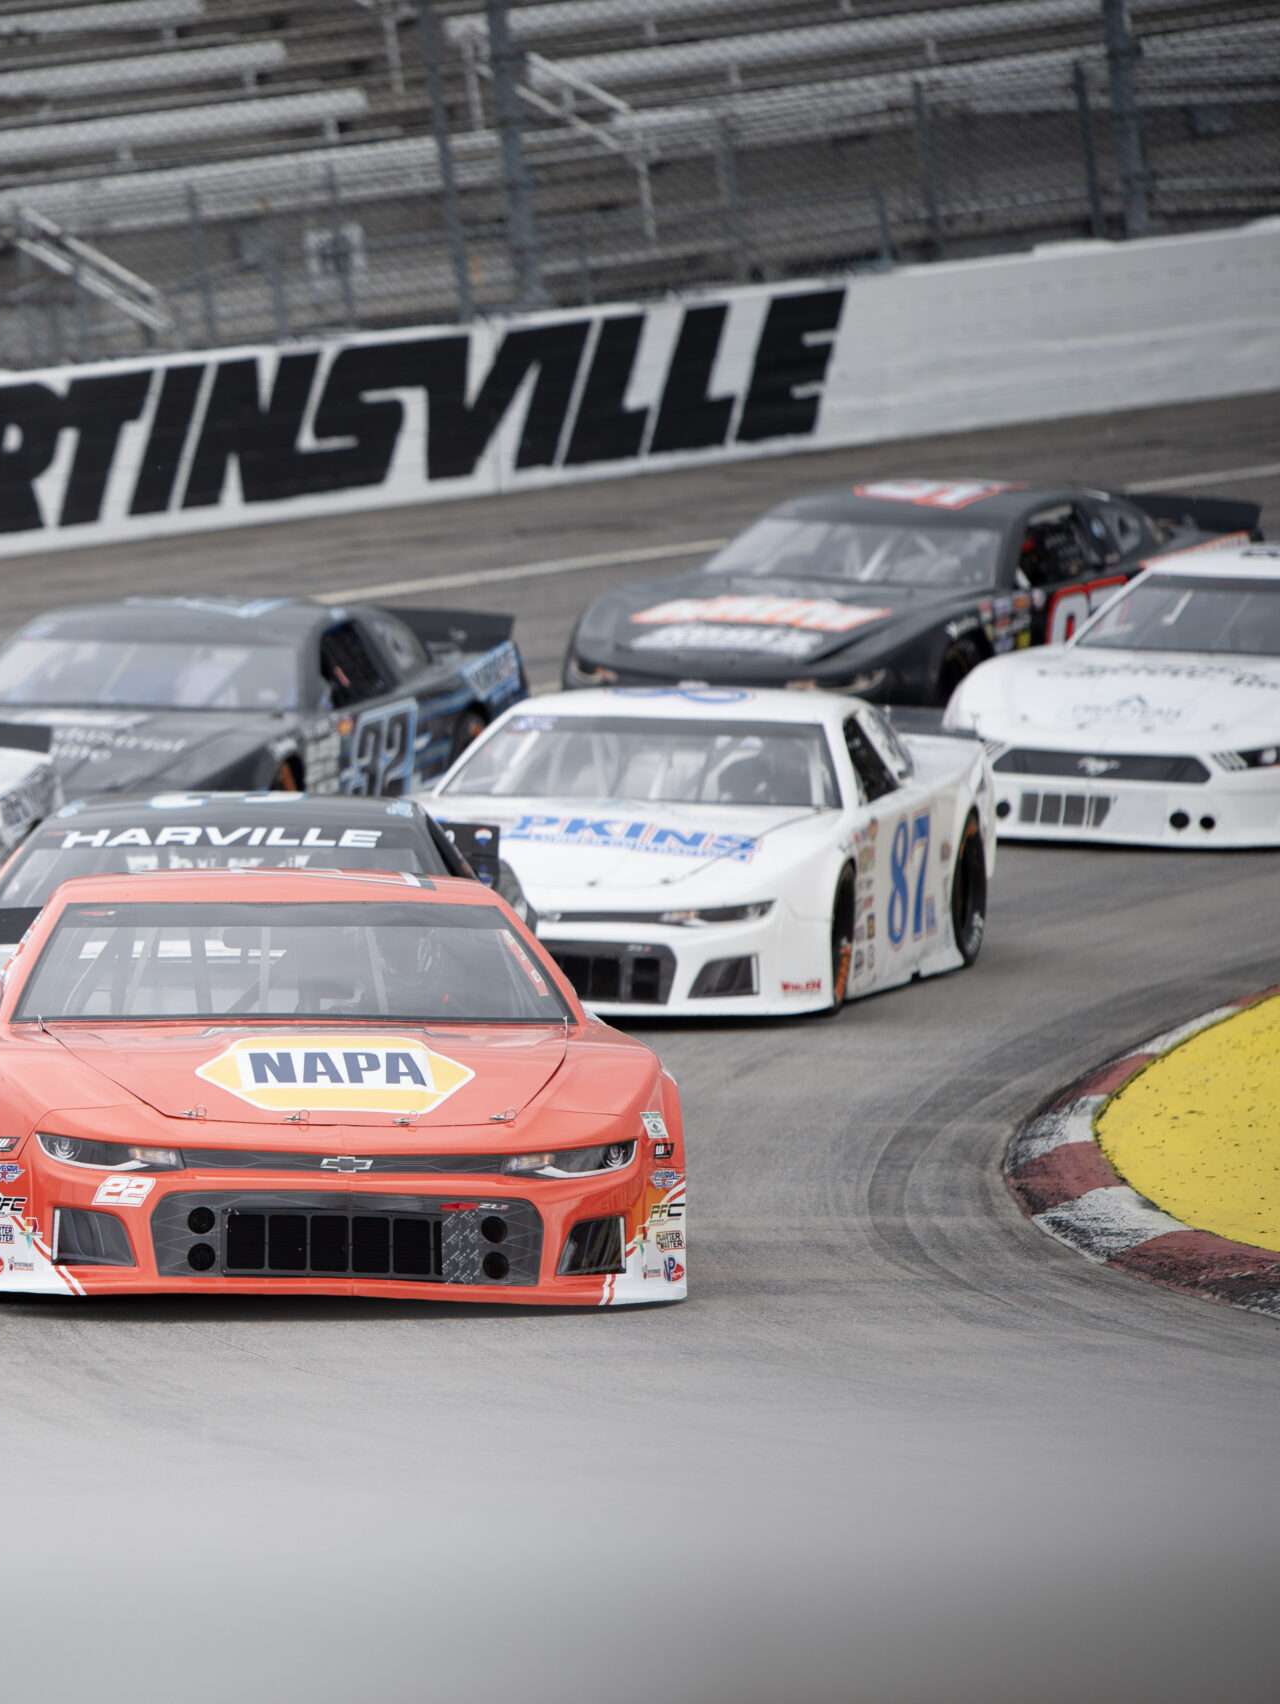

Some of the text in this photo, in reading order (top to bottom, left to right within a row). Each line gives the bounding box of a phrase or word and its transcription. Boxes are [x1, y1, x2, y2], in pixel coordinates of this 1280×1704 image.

[61, 826, 383, 849] HARVILLE
[888, 808, 931, 950] 87
[248, 1052, 427, 1087] NAPA
[91, 1175, 156, 1207] 22
[650, 1203, 686, 1219] PFC
[663, 1256, 676, 1281] VP
